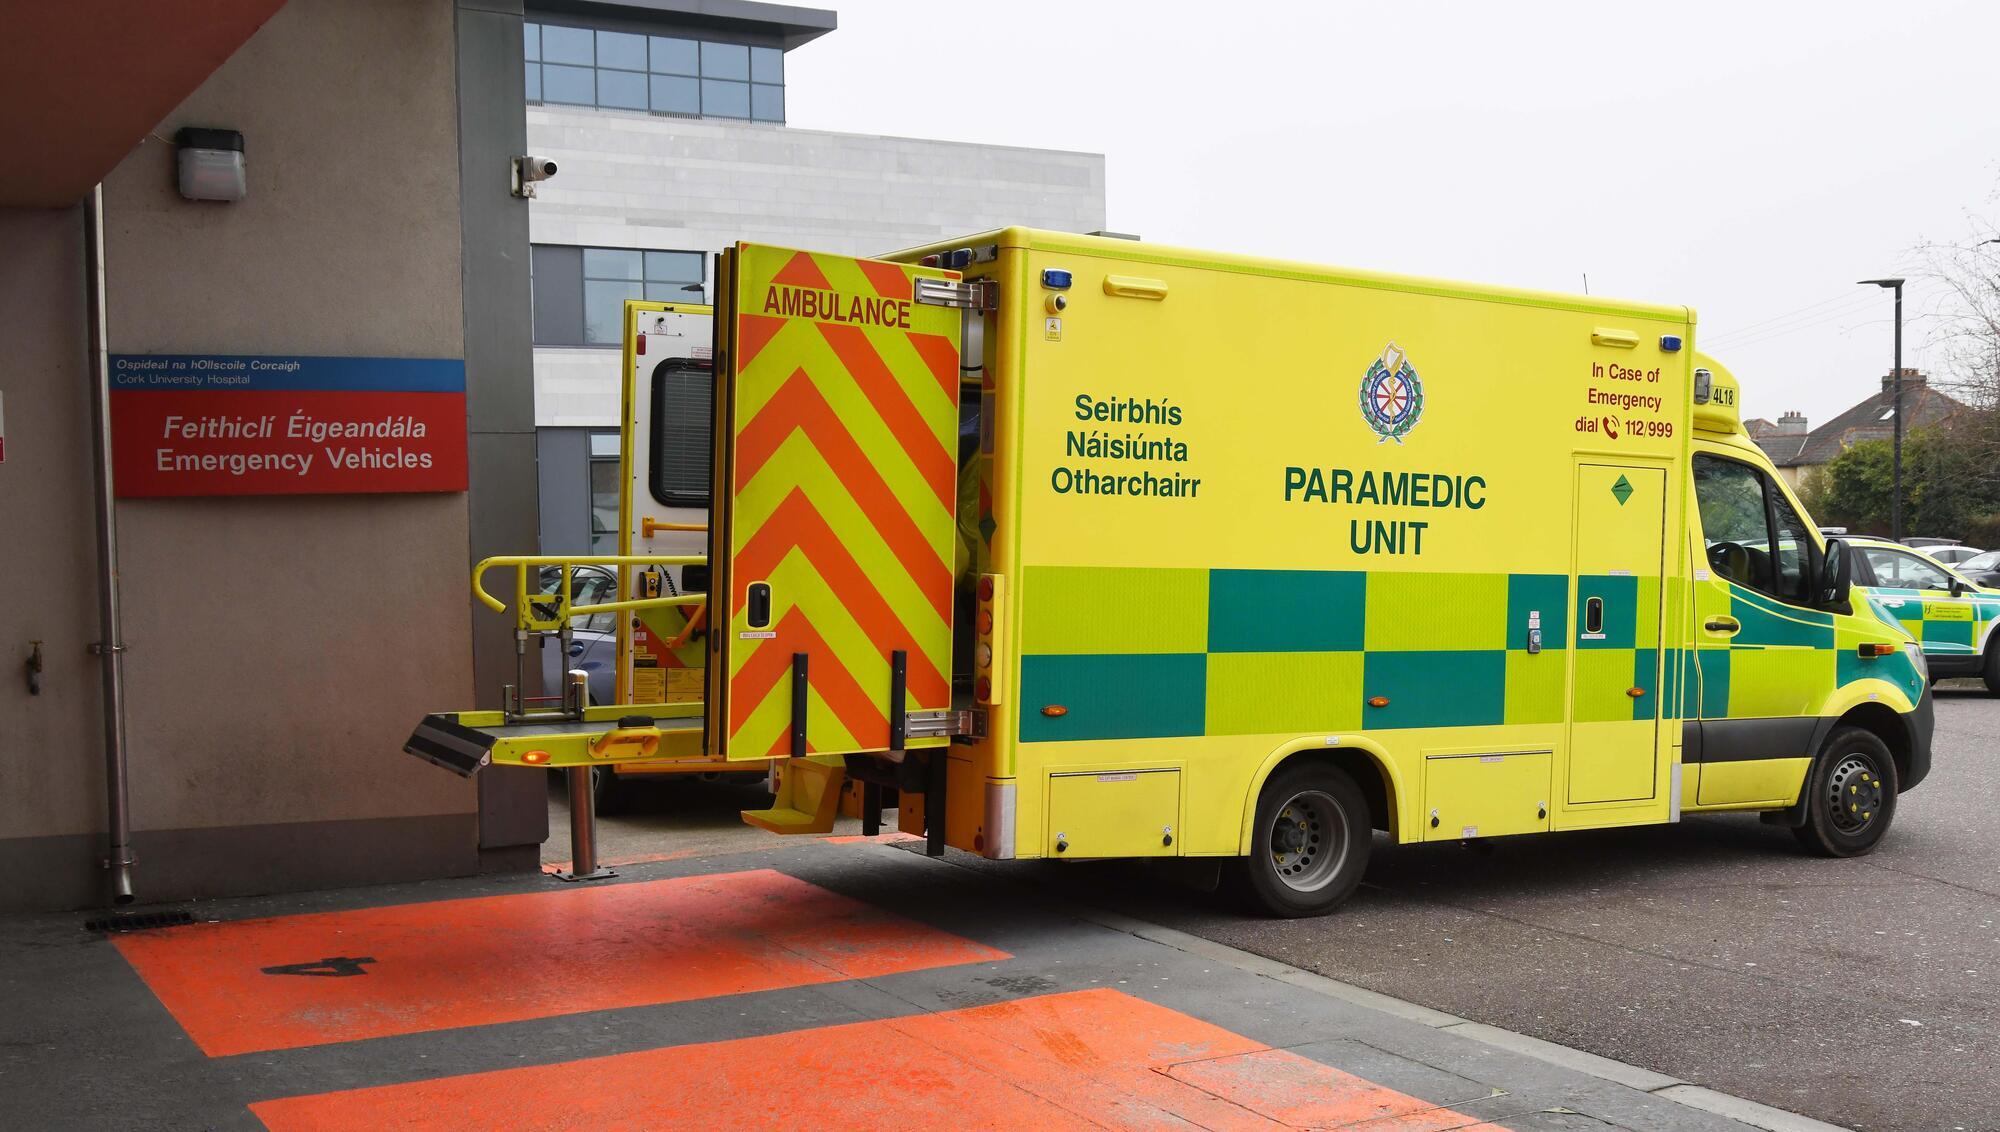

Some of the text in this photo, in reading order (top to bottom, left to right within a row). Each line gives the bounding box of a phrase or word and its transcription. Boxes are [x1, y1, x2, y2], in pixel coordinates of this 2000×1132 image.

[763, 285, 911, 329] AMBULANCE
[116, 359, 301, 372] Ospideal na hOllscoile Corcaigh
[116, 373, 250, 386] Cork University Hospital
[1592, 361, 1660, 383] In Case of
[1074, 393, 1183, 426] Seirbhís
[1588, 388, 1662, 413] Emergency
[1713, 387, 1734, 406] 4L18
[163, 408, 427, 442] Feithiclí Éigeandála
[1575, 416, 1673, 438] dial 112/999
[156, 446, 433, 475] Emergency Vehicles
[1066, 430, 1189, 462] Náisiúnta
[1051, 466, 1201, 498] Otharchairr
[1284, 466, 1487, 510] PARAMEDIC
[1349, 519, 1429, 556] UNIT
[260, 956, 379, 978] 4
